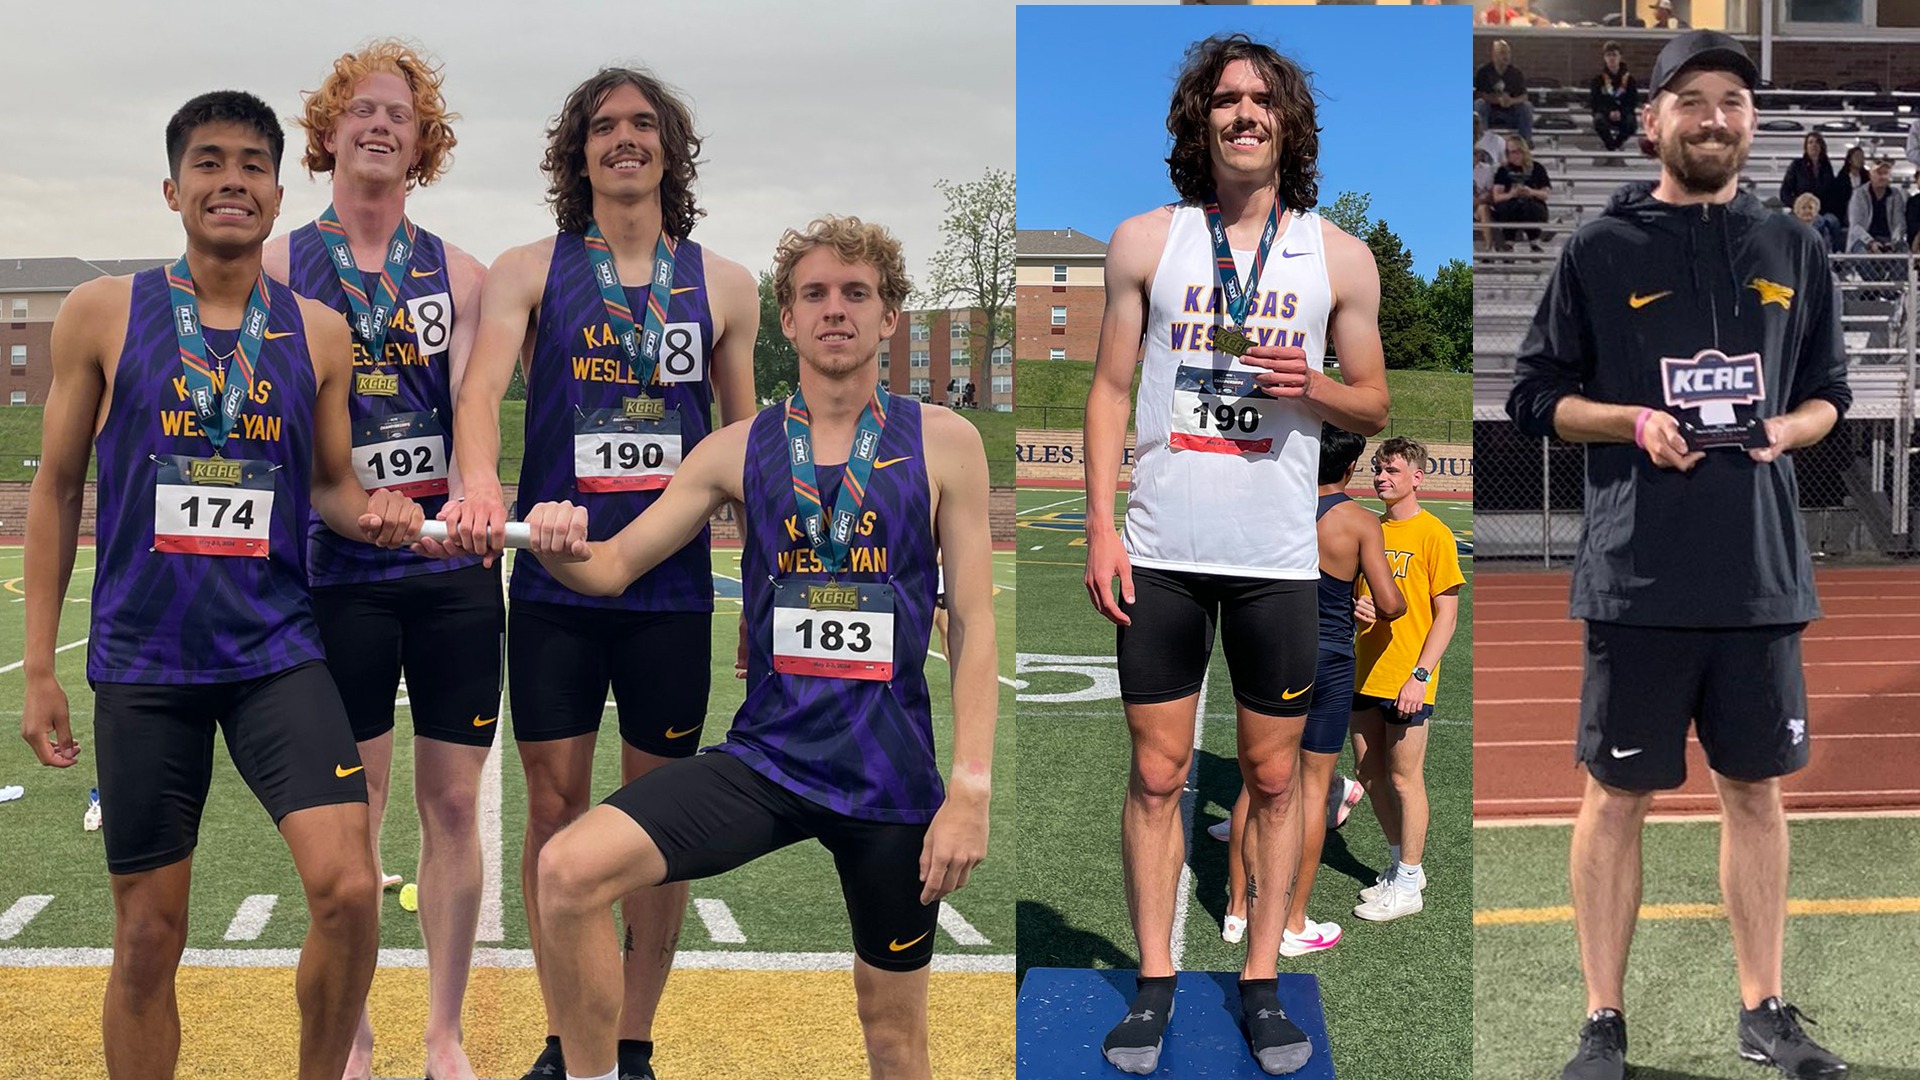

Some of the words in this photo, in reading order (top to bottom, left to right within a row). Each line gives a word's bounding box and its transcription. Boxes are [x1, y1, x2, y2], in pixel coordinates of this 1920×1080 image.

[600, 262, 613, 285] KCAC
[658, 261, 668, 286] KCAC
[1182, 284, 1298, 320] KASAS
[180, 308, 193, 333] KCAC
[249, 311, 262, 336] KCAC
[360, 314, 370, 339] KCAC
[373, 307, 385, 332] KCAC
[418, 300, 447, 347] 8
[624, 333, 636, 357] KCAC
[646, 332, 656, 357] KCAC
[665, 328, 695, 375] 8
[173, 370, 272, 404] KNS
[359, 378, 397, 390] KCAC
[1673, 365, 1755, 394] KCAC
[197, 390, 211, 416] KCAC
[226, 388, 240, 416] KCAC
[626, 401, 662, 413] KCAC
[1193, 402, 1259, 433] 190
[595, 442, 664, 469] 190
[795, 438, 805, 461] KCAC
[860, 432, 873, 458] KCAC
[194, 463, 240, 478] KCAC
[367, 446, 434, 480] 192
[181, 496, 254, 530] 174
[808, 518, 822, 544] KCAC
[837, 513, 851, 541] KCAC
[811, 592, 856, 604] KCAC
[795, 619, 872, 653] 183
